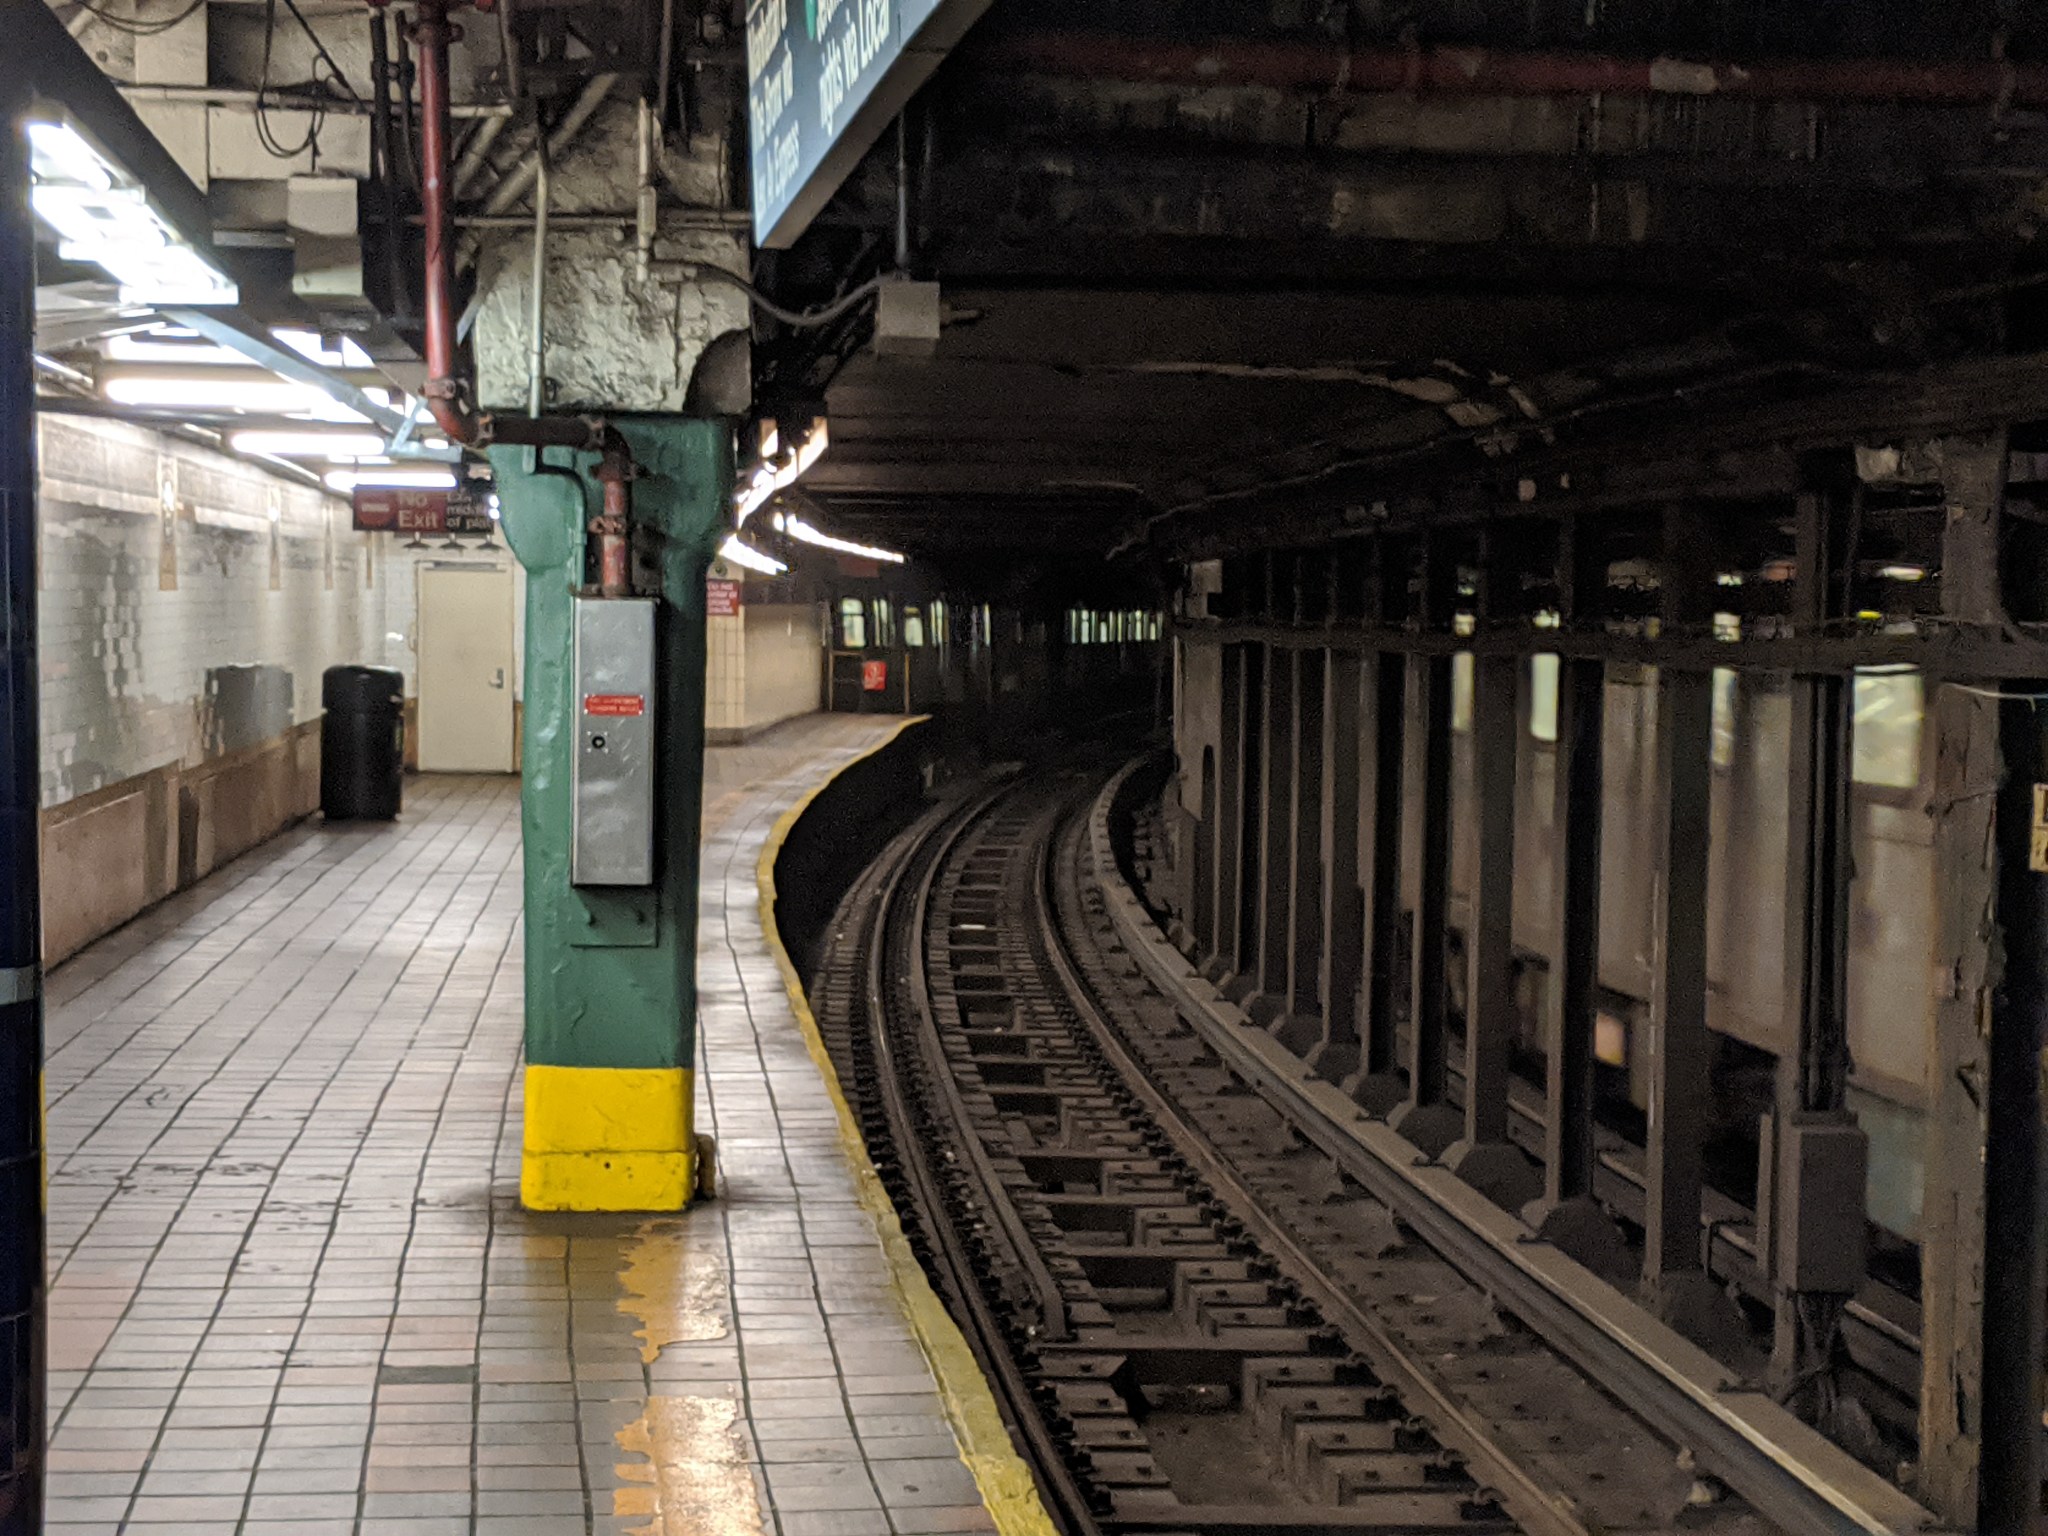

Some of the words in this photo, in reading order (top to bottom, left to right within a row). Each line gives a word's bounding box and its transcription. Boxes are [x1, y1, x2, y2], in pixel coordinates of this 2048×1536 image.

[842, 8, 859, 91] via
[399, 491, 428, 508] No
[399, 510, 438, 528] Exit
[446, 516, 461, 528] of
